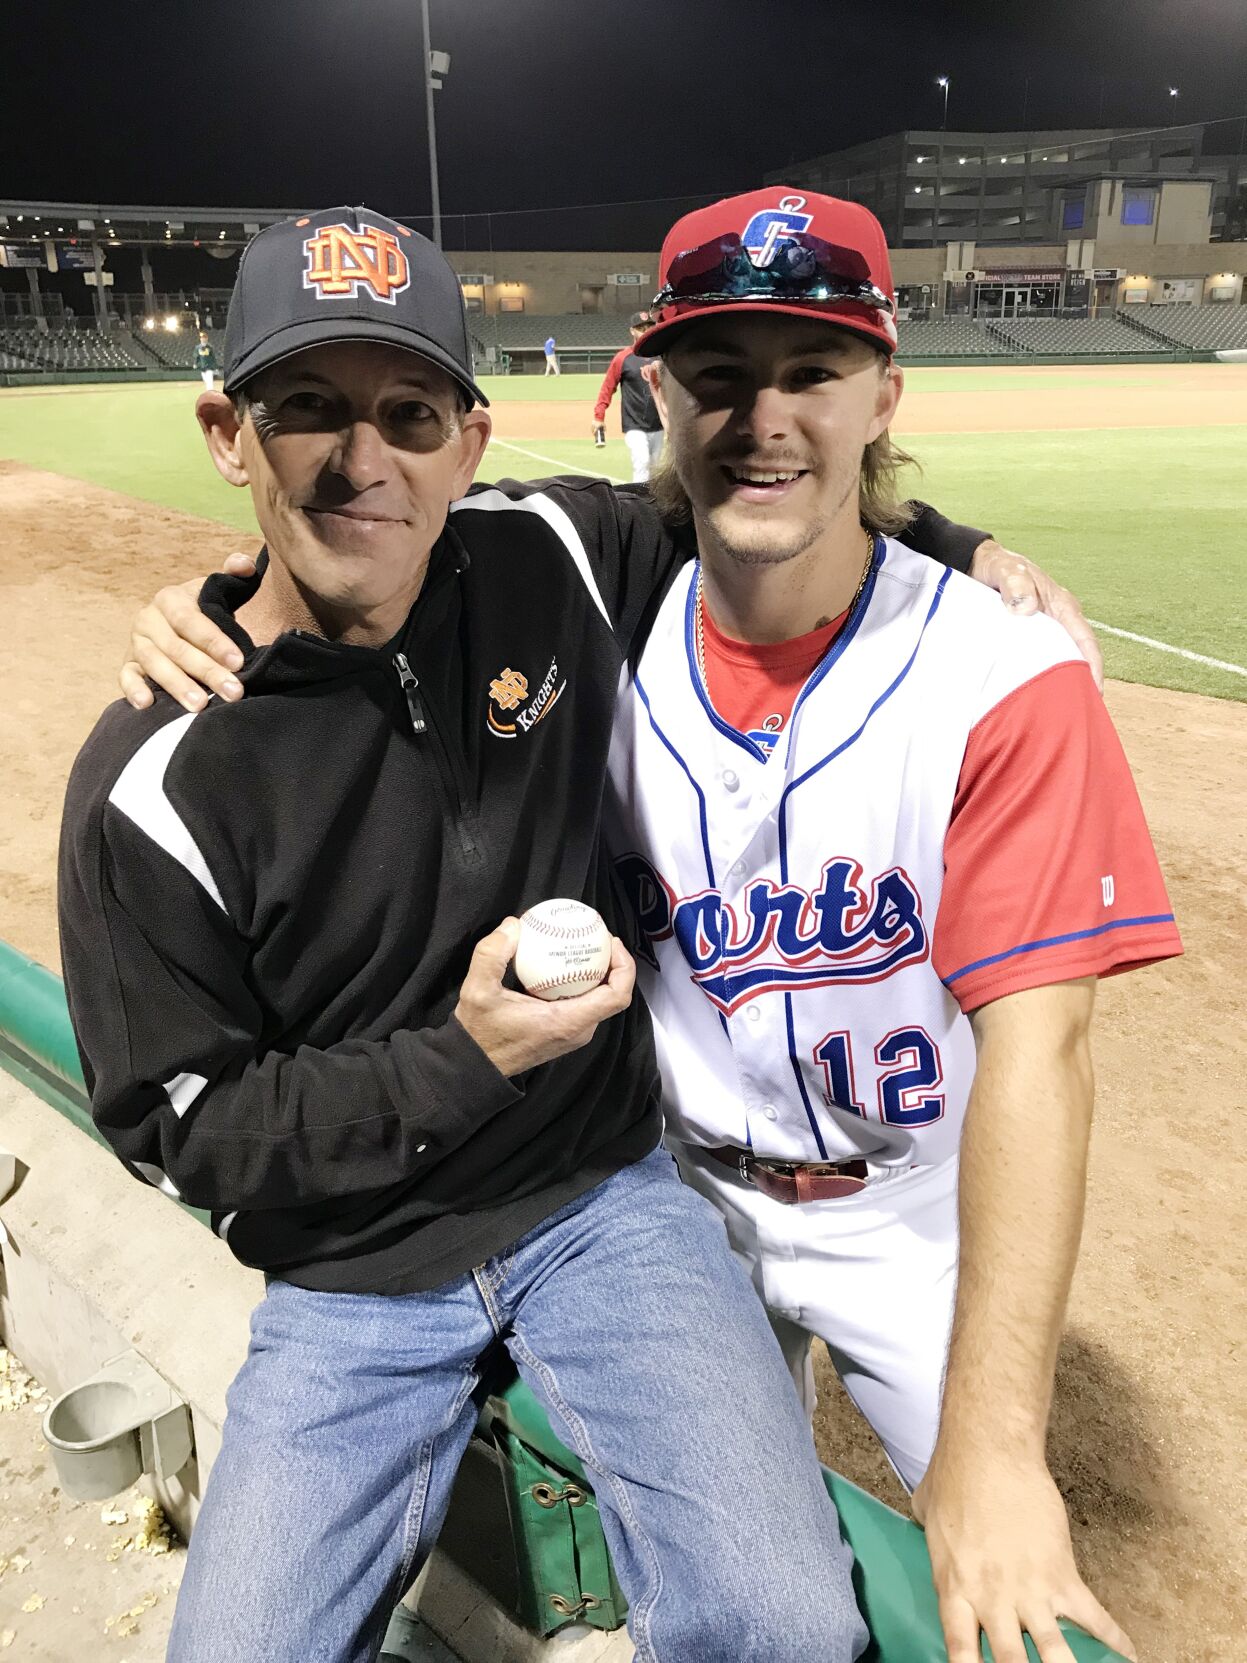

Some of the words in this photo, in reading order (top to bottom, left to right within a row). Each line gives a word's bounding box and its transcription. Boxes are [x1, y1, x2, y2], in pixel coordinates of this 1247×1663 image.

[304, 223, 410, 305] ND
[516, 655, 558, 732] KNIGHTS
[813, 1025, 946, 1128] 12
